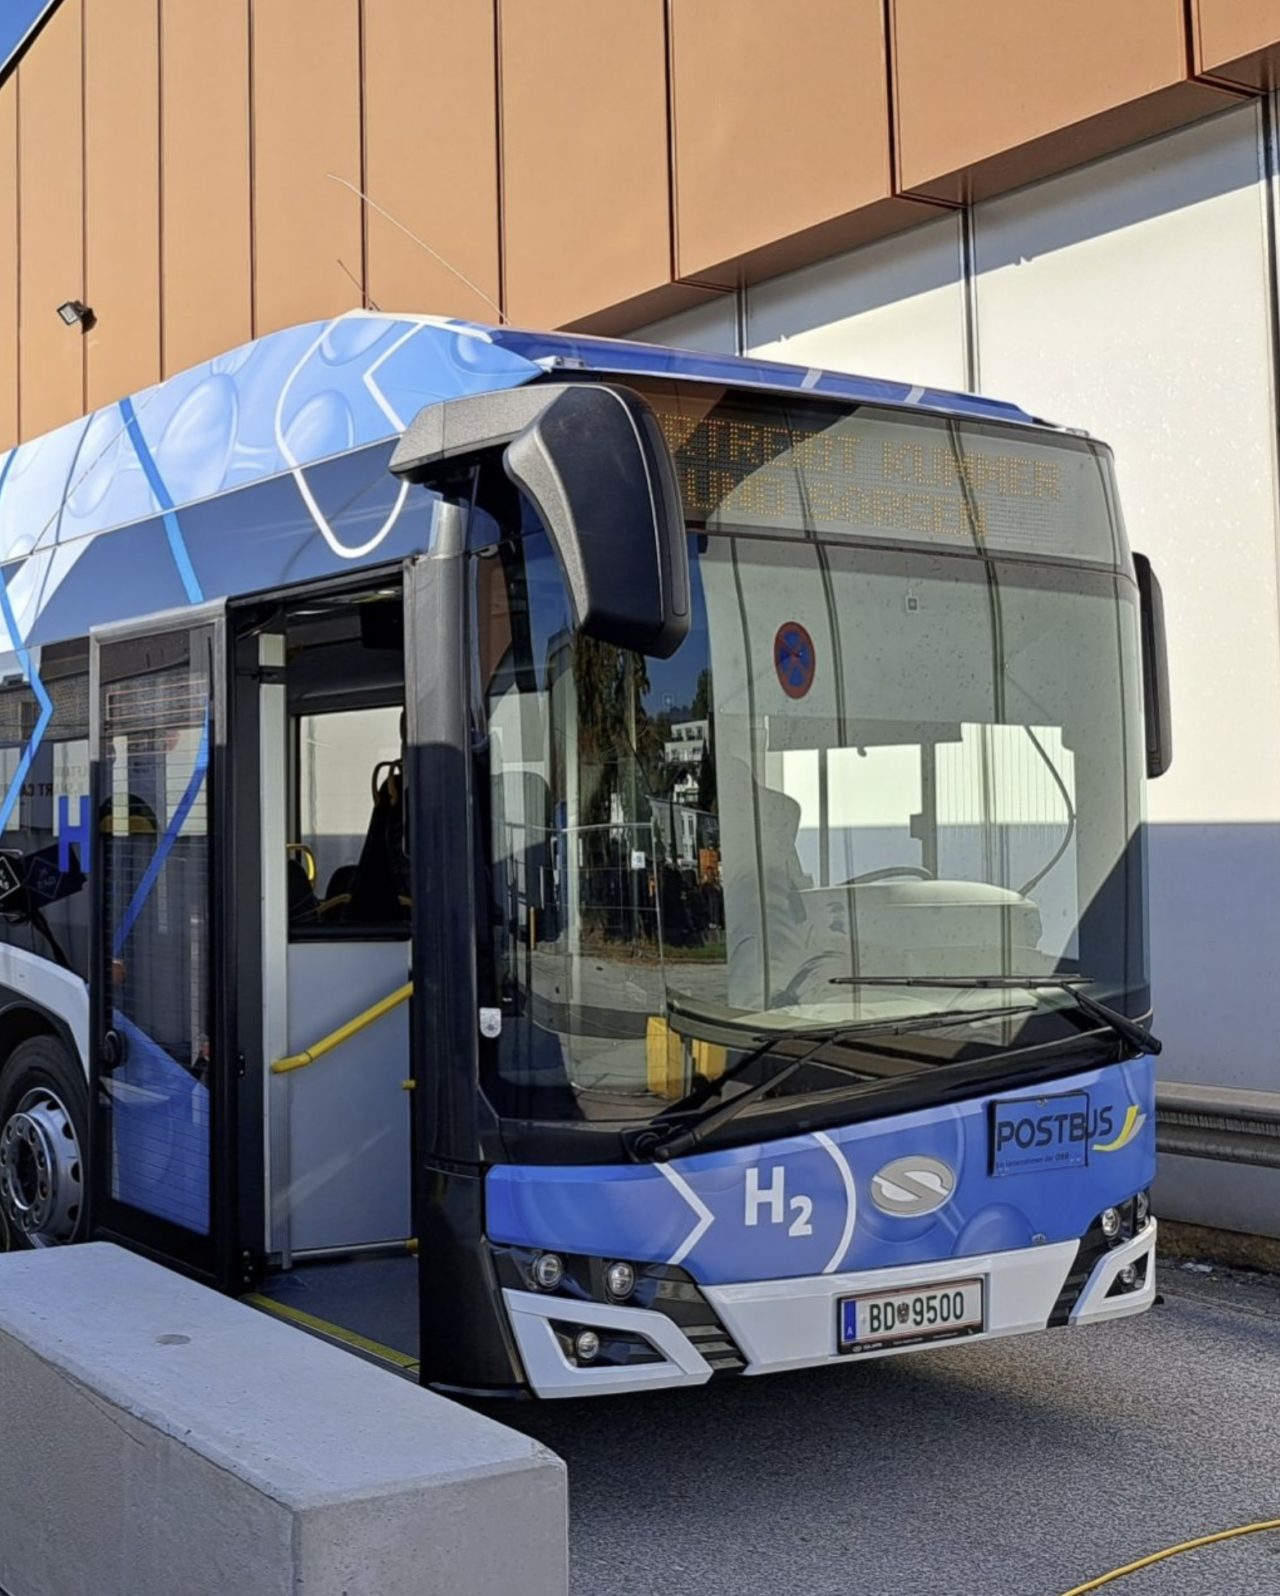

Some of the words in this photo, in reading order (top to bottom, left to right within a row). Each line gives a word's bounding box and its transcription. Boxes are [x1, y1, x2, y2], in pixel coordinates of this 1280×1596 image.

[883, 440, 1060, 499] KUMMER
[686, 466, 786, 518] UND
[810, 482, 988, 537] SORGEN
[996, 1104, 1114, 1153] POSTBUS
[869, 1301, 896, 1333] BD
[912, 1291, 965, 1327] 9500
